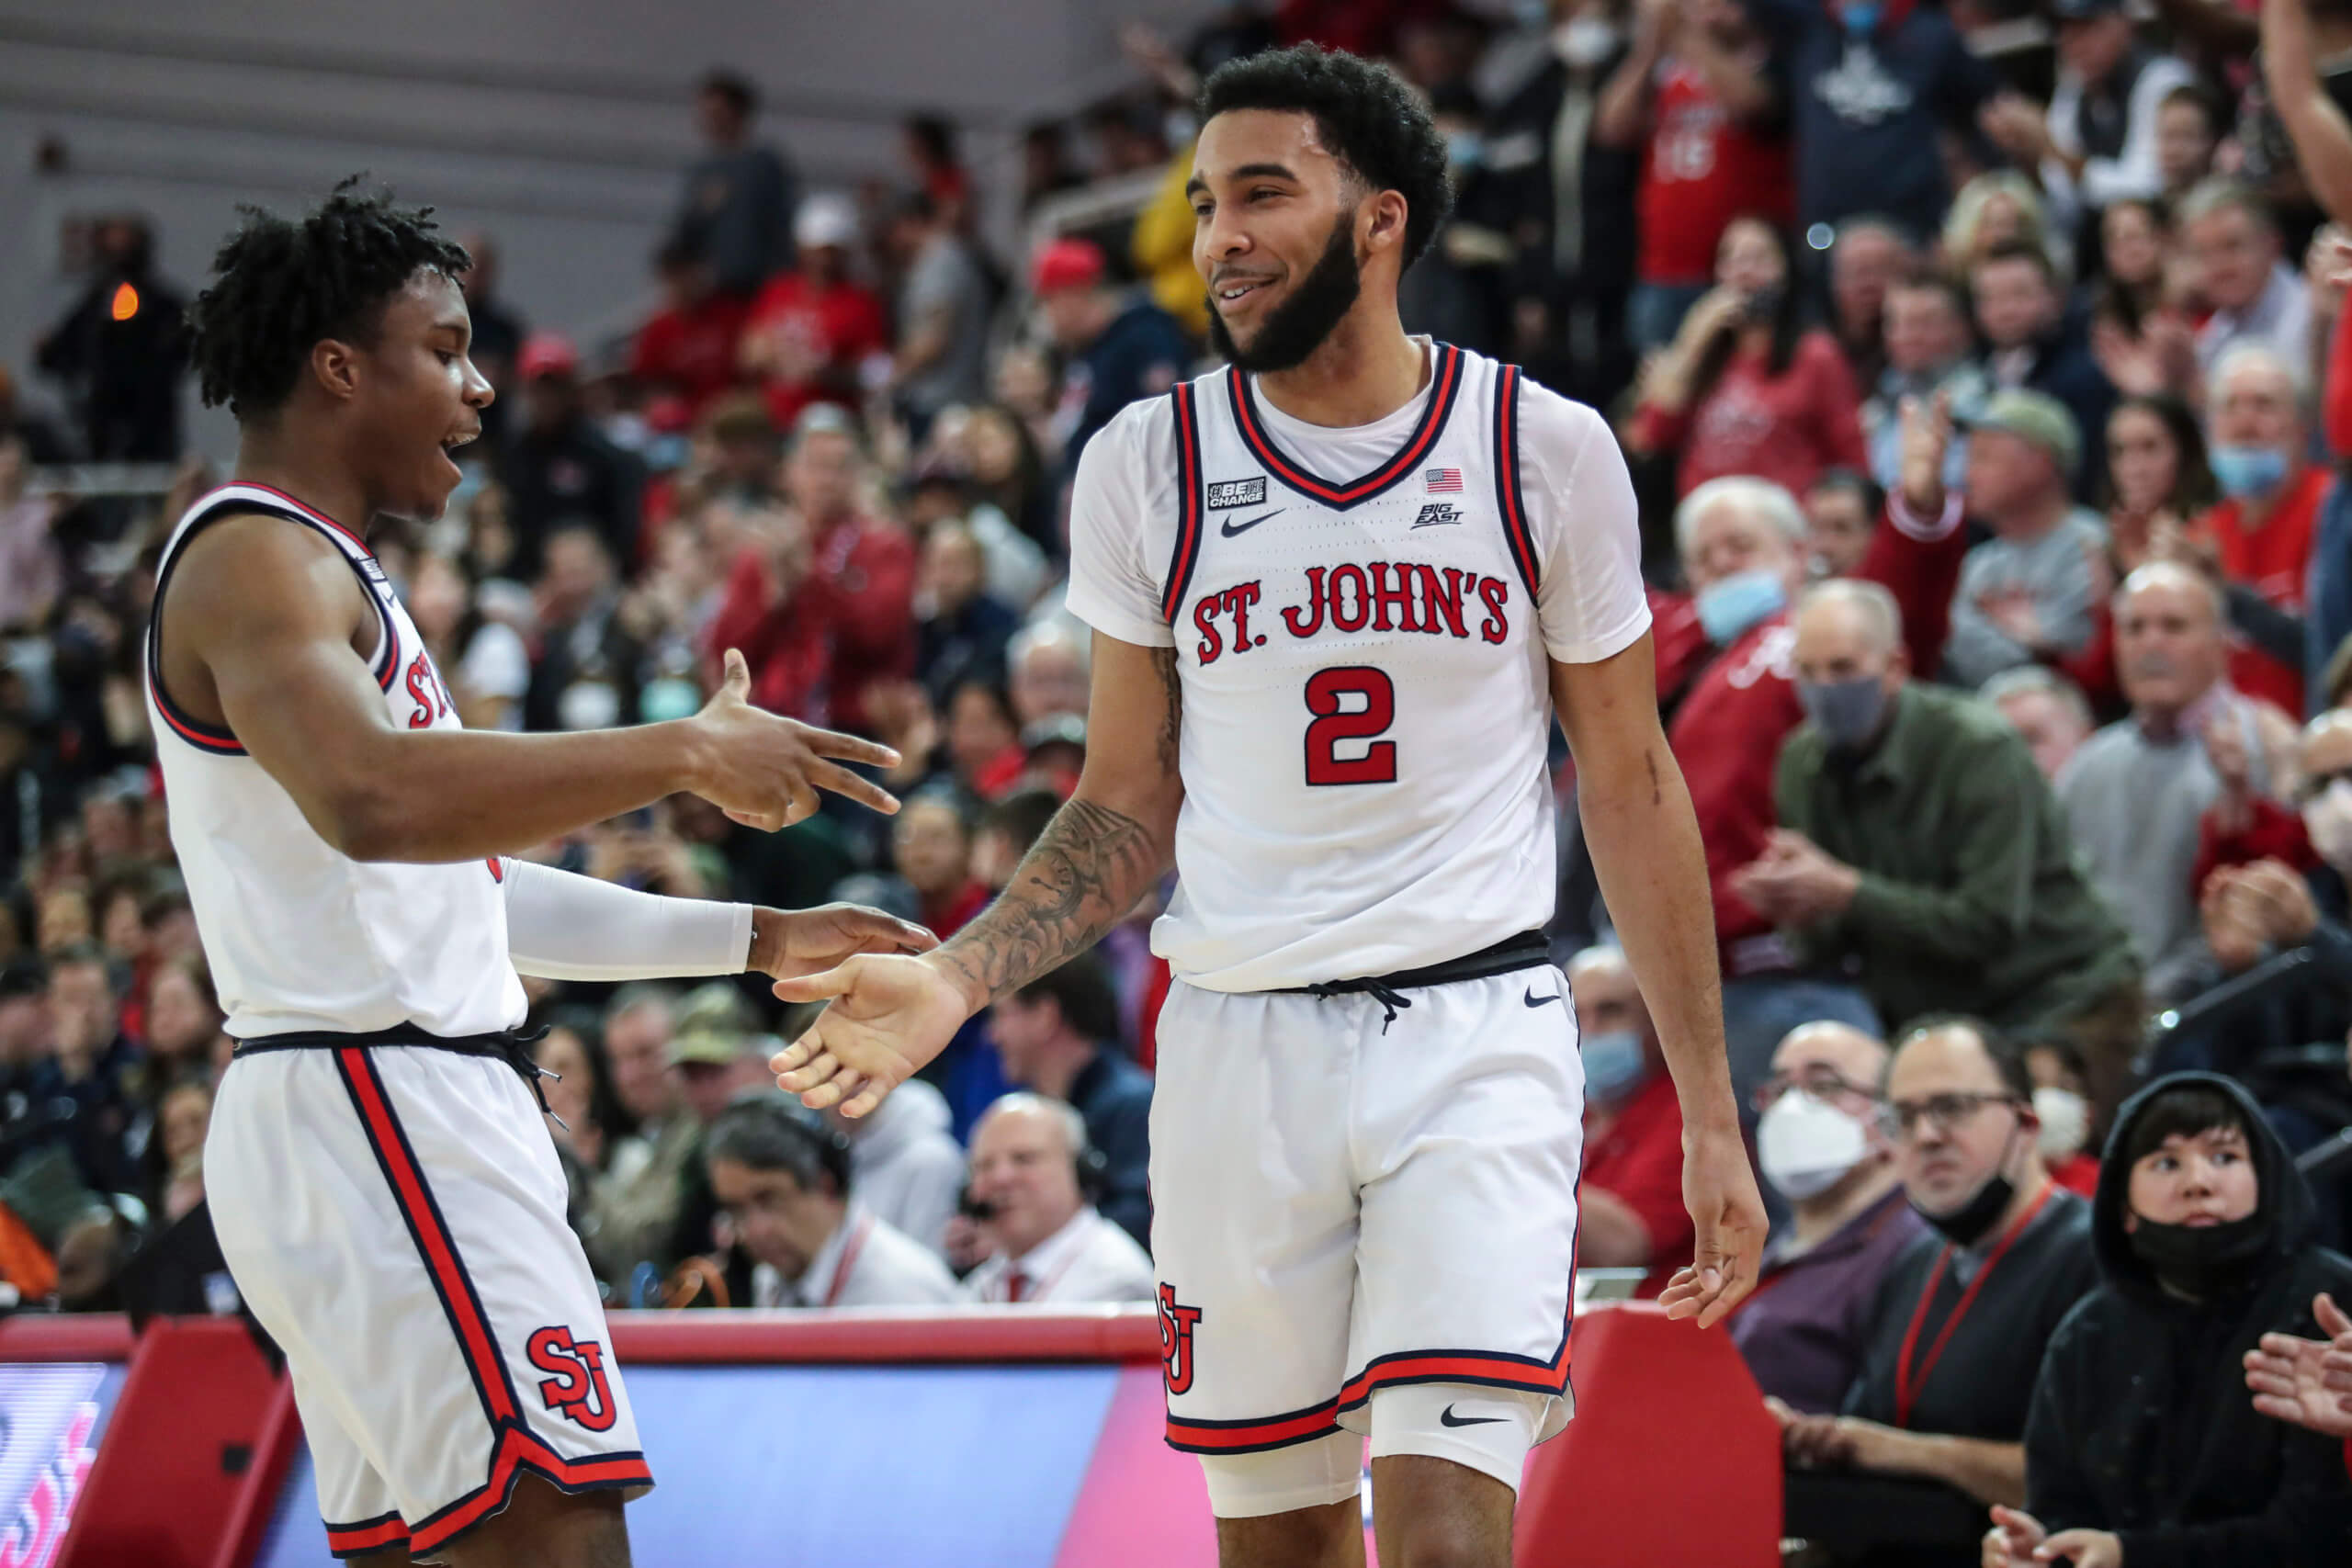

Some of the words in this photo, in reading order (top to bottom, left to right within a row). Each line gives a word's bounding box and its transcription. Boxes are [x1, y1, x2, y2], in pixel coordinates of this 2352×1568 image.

[1210, 492, 1263, 507] CHANGE
[1419, 503, 1453, 514] BIG
[1415, 512, 1463, 524] EAST
[1193, 580, 1267, 667] ST.
[1280, 562, 1509, 645] JOHN'S
[1305, 666, 1396, 786] 2
